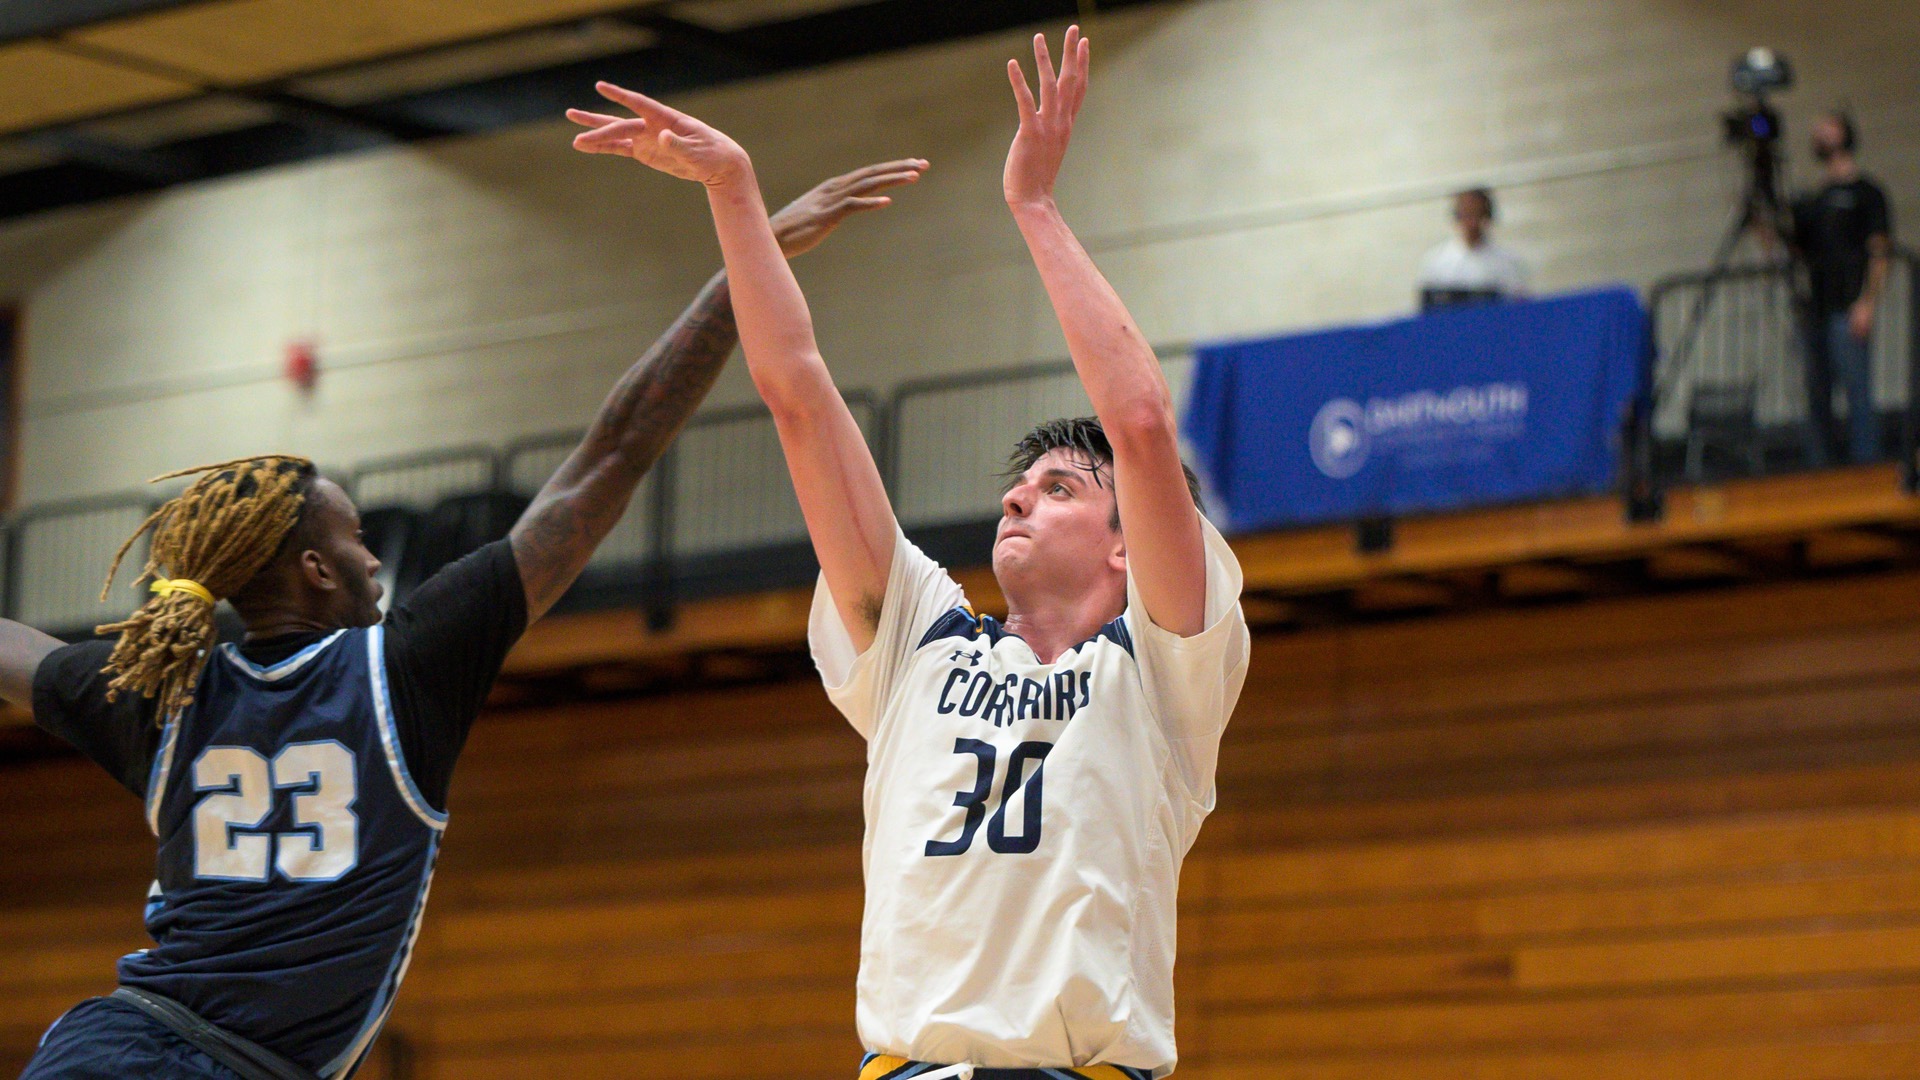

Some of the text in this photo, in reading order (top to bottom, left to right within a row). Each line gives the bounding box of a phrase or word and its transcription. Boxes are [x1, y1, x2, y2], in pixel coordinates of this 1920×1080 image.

[937, 668, 1091, 728] CORSAIRS
[193, 739, 360, 883] 23
[924, 737, 1054, 857] 30
